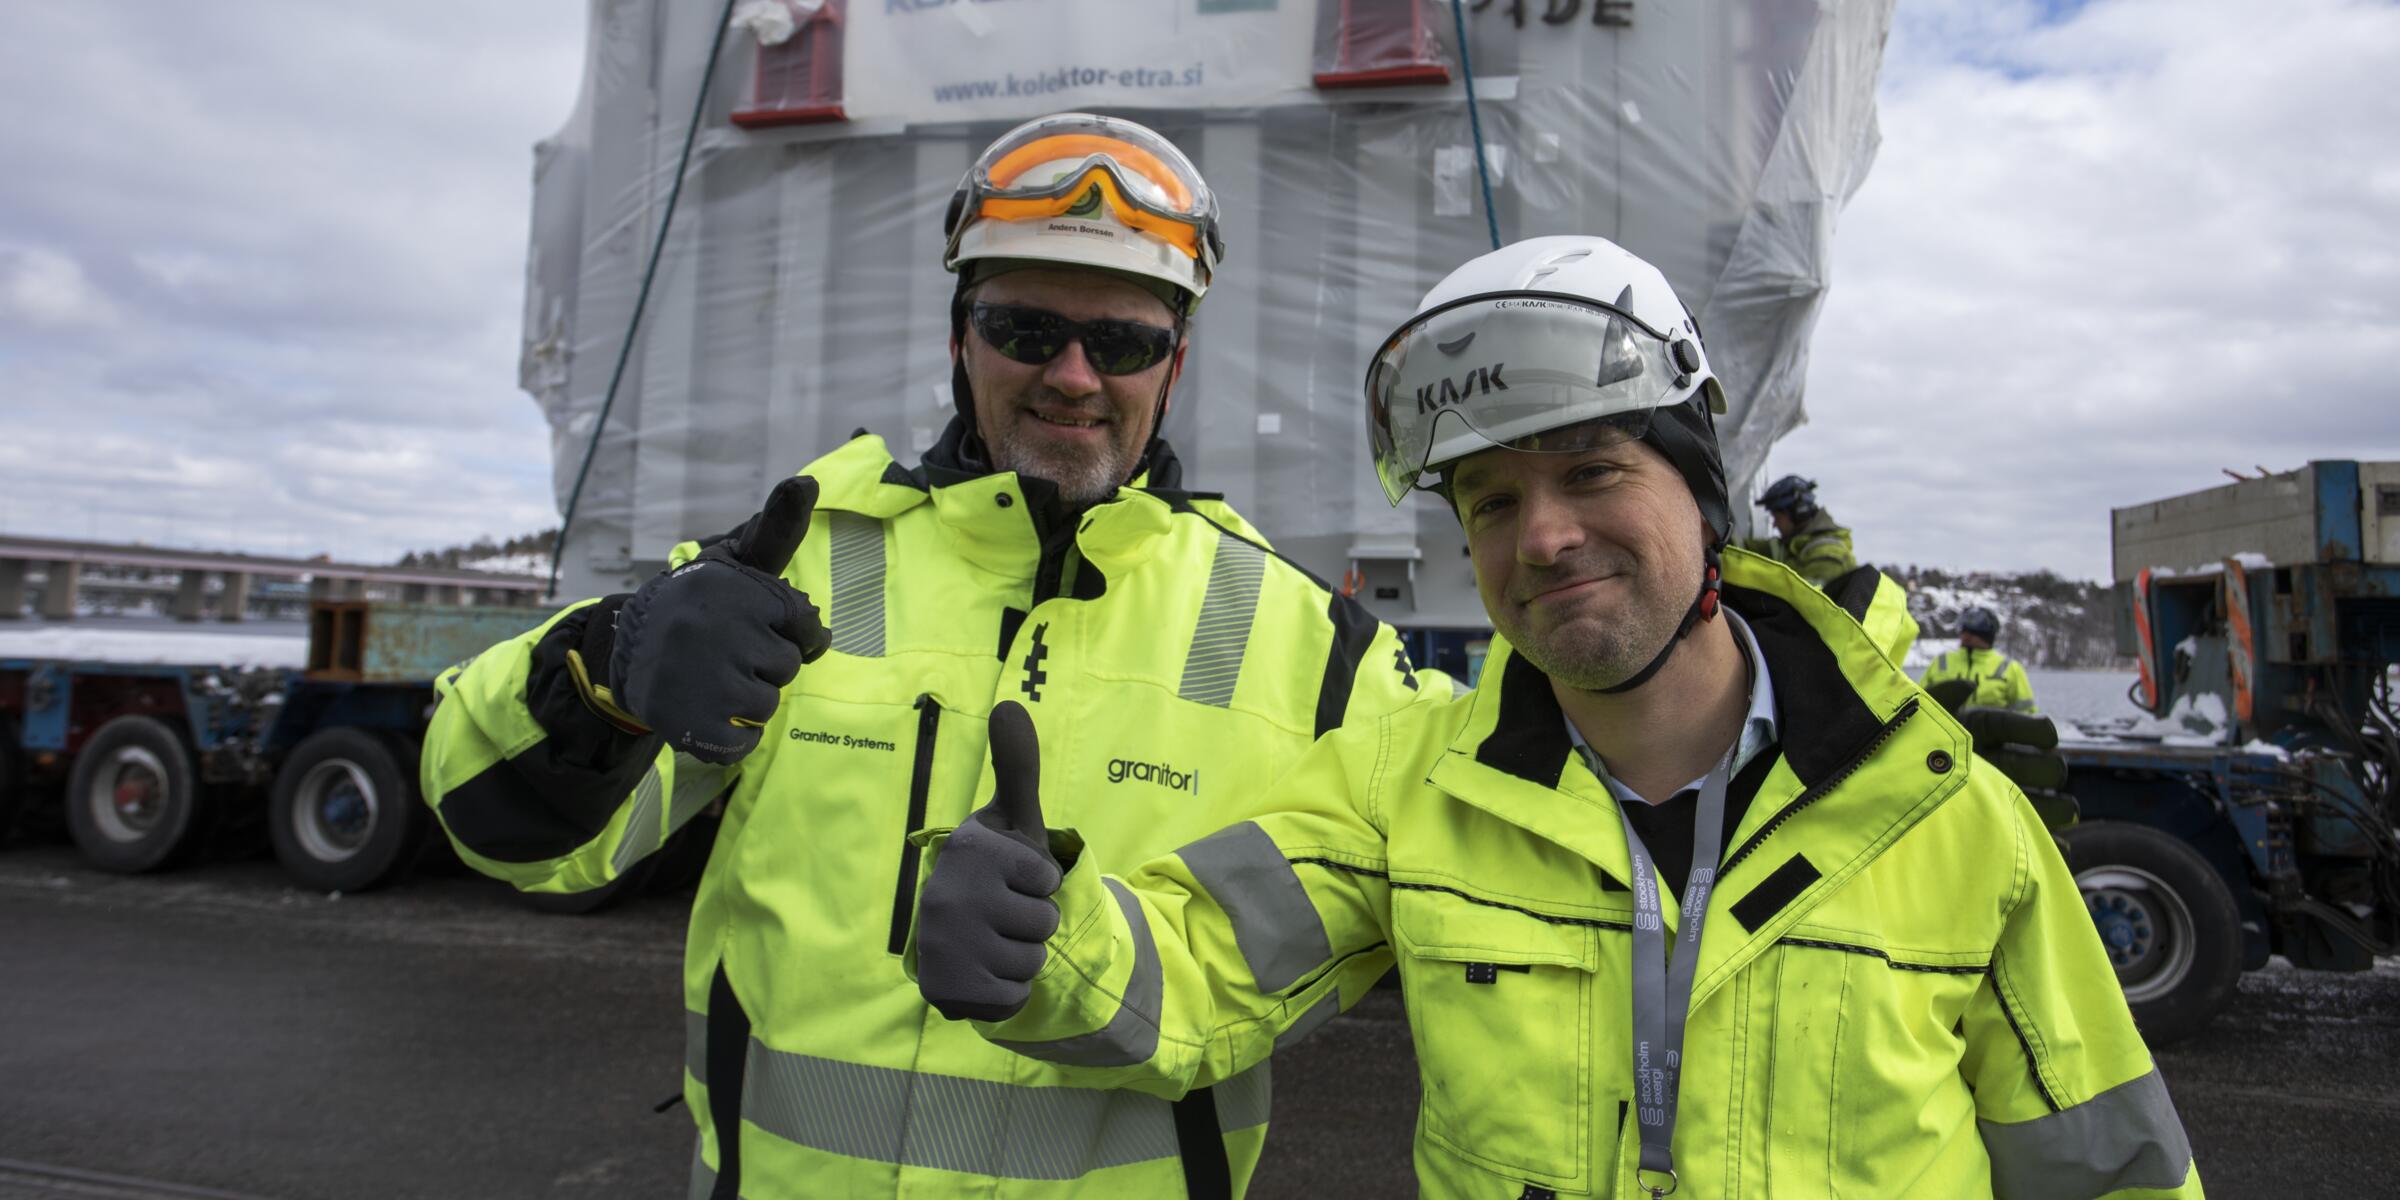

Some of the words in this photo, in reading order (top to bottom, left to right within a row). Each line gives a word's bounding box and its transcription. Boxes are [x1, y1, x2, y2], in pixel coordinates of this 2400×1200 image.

[933, 63, 1205, 101] www.kolektor-etra.si
[1048, 223, 1077, 232] Anders
[1522, 300, 1547, 309] KASK
[1417, 362, 1509, 415] KASK
[789, 728, 840, 745] Granitor
[843, 735, 896, 752] Systems
[1107, 758, 1192, 791] granitor
[1635, 854, 1648, 910] stockholm
[1646, 878, 1658, 911] exergi
[1682, 886, 1697, 917] exergi
[1688, 886, 1706, 942] stockholm
[1638, 1041, 1652, 1104] stockholm
[1650, 1068, 1664, 1105] exergi
